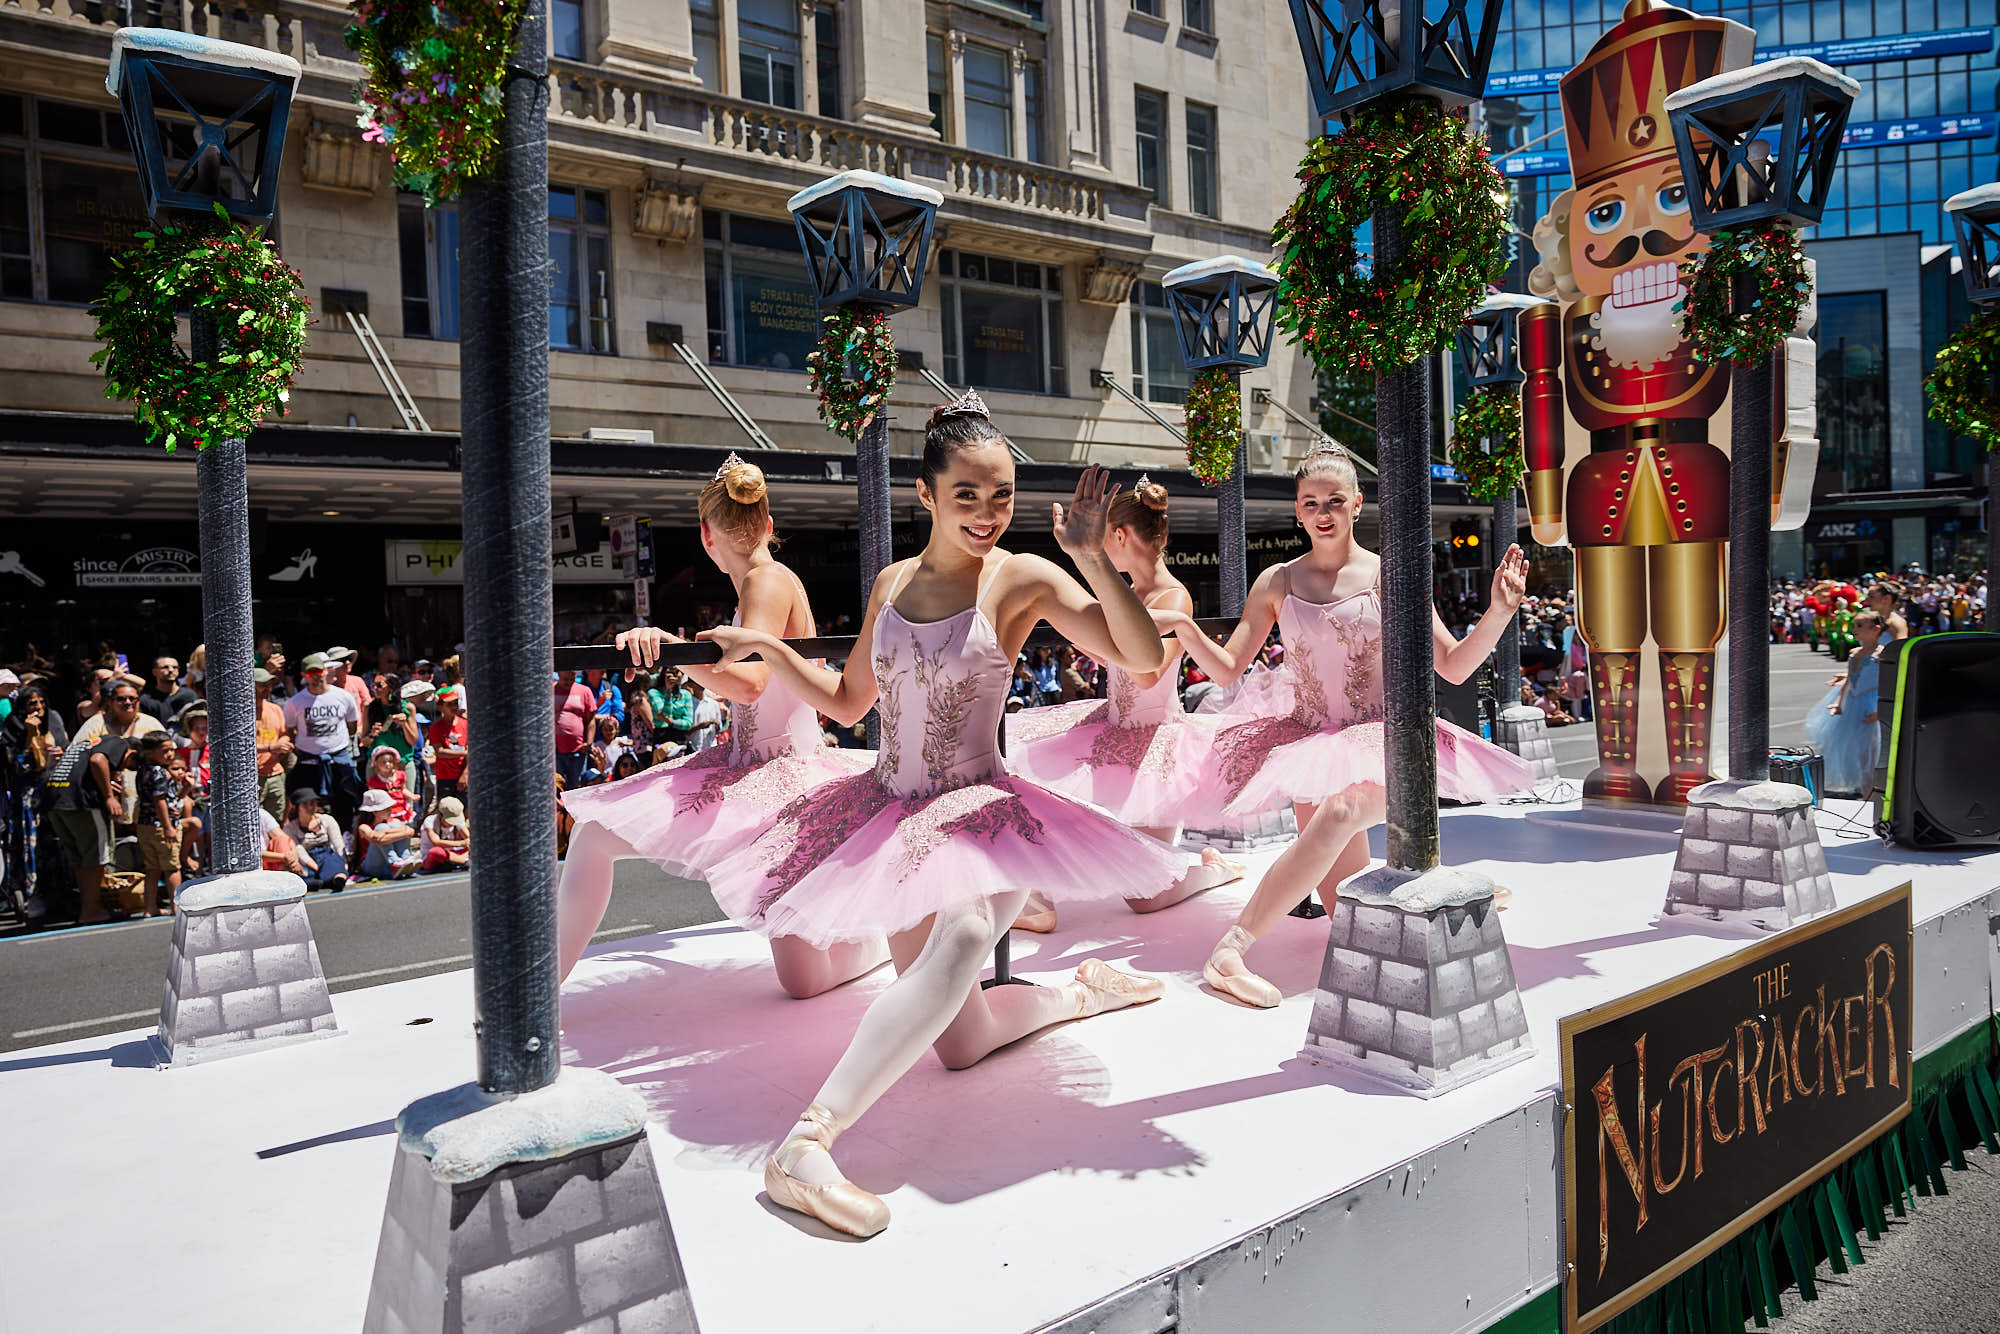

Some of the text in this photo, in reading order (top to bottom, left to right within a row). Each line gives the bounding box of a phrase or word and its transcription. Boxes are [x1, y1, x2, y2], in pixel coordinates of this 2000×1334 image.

[760, 288, 815, 305] STRATA TITLE
[750, 300, 775, 315] BODY
[760, 316, 817, 333] MANAGEMENT
[1817, 522, 1857, 538] ANZ
[1247, 537, 1265, 550] leef
[73, 556, 119, 572] since
[134, 550, 193, 566] MISTRY
[406, 554, 604, 569] PHI AGE
[1176, 552, 1202, 566] Cleef
[1202, 554, 1209, 565] &
[85, 576, 115, 584] SHOE
[118, 576, 161, 584] REPAIRS
[163, 576, 172, 584] &
[174, 576, 193, 584] KEY
[304, 704, 340, 719] ROCKY
[1752, 961, 1792, 1010] THE
[1591, 942, 1900, 1286] NUTCRACKER
